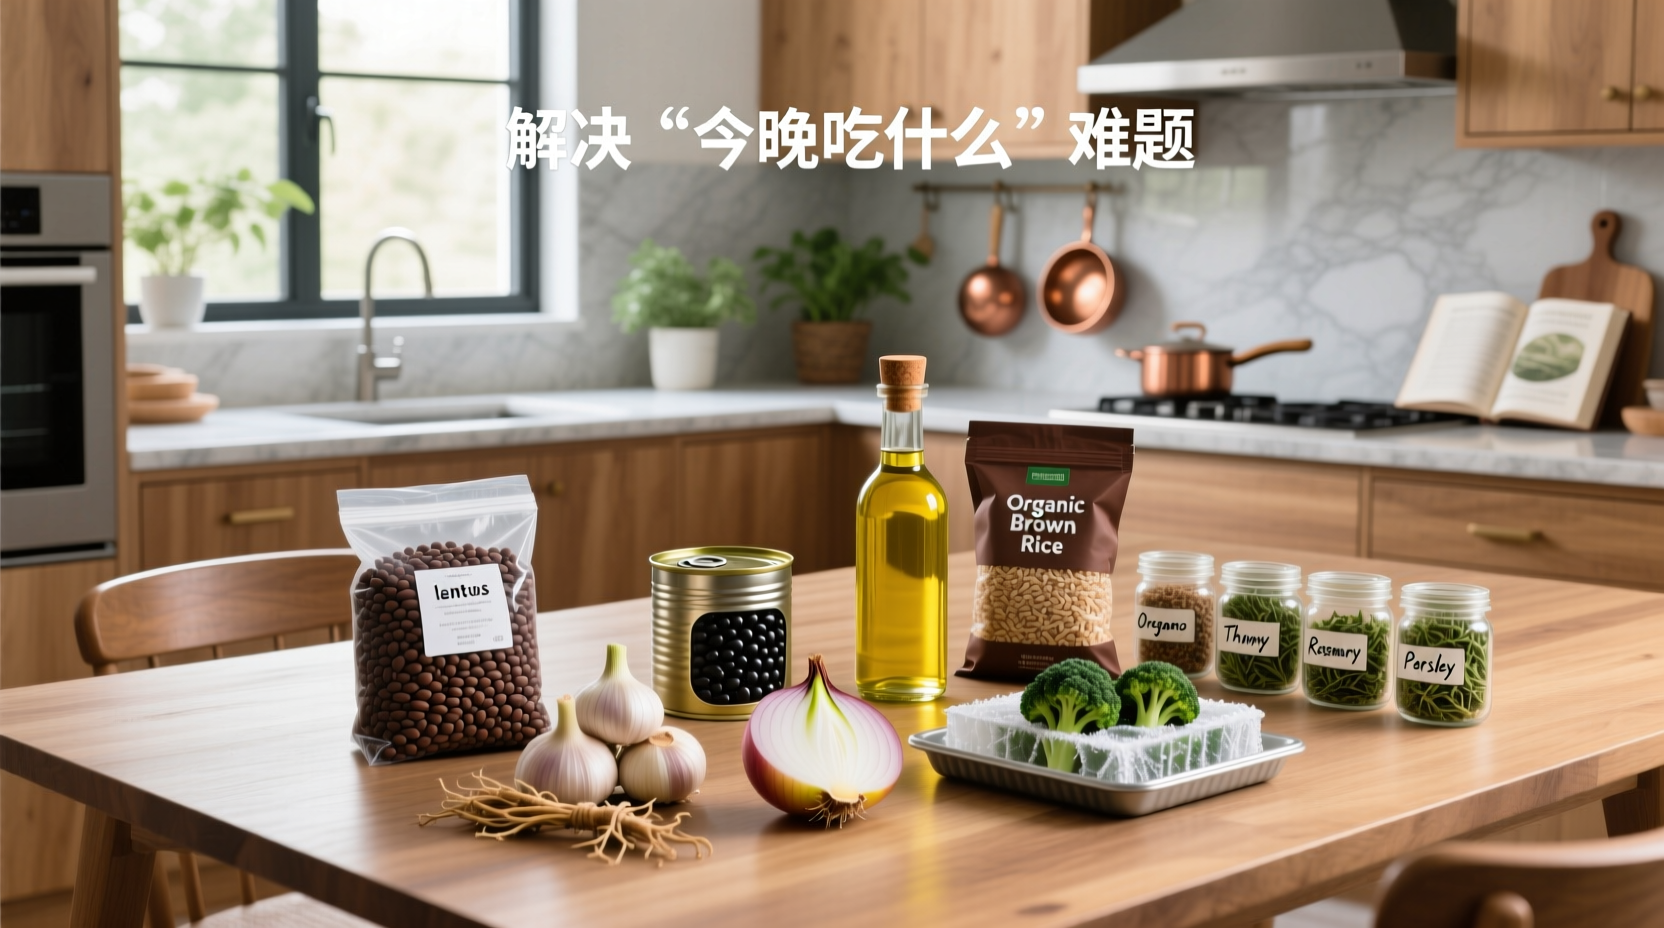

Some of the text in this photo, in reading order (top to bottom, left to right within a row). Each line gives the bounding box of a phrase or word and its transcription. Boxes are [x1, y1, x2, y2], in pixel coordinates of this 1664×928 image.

[1007, 494, 1085, 518] Organic
[1010, 514, 1077, 534] Brown
[1021, 534, 1063, 554] Rice
